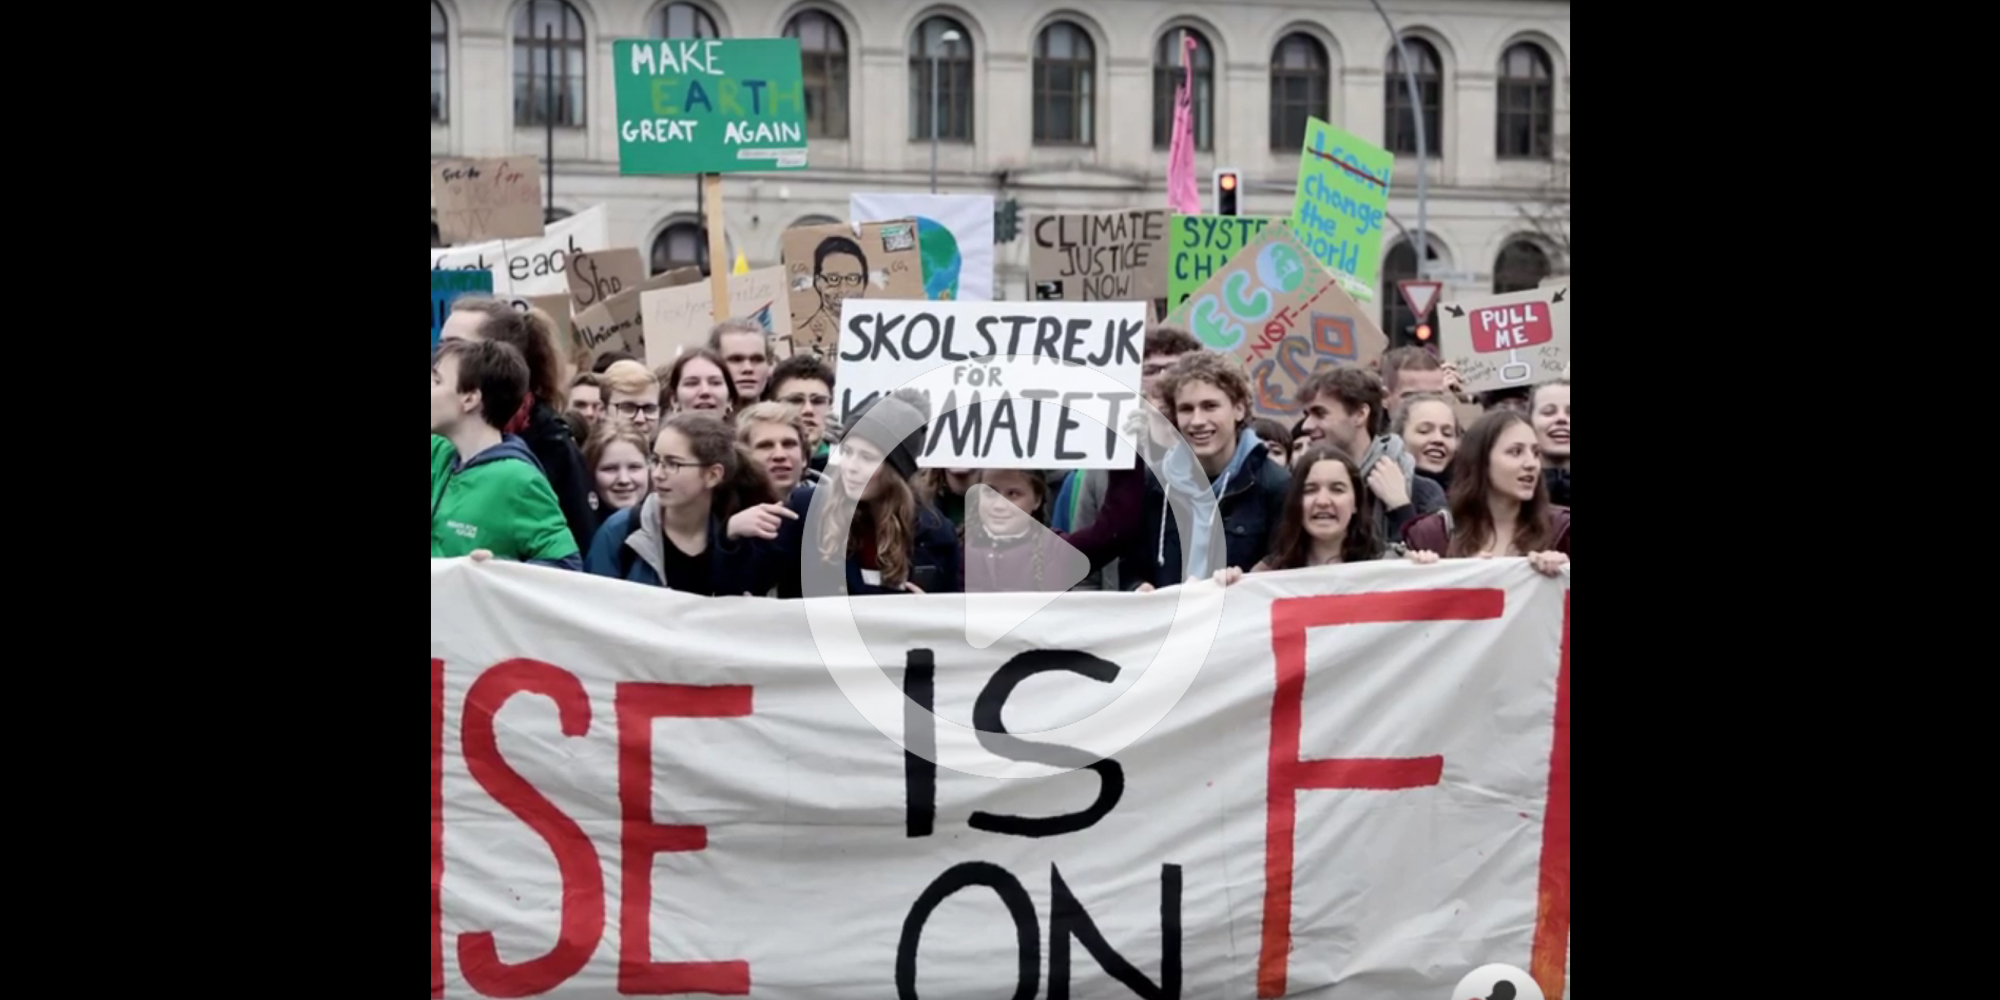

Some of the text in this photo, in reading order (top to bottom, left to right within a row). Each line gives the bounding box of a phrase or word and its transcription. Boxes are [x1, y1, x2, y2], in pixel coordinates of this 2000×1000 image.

[631, 41, 724, 75] MAKE
[651, 79, 800, 116] EARTH
[622, 119, 801, 144] GREAT AGAIN
[1301, 199, 1336, 237] the
[1304, 173, 1383, 235] change
[1034, 210, 1164, 248] CLIMATE
[1183, 216, 1287, 250] SYST
[1059, 242, 1152, 276] JUSTICE
[1082, 274, 1130, 301] NOW
[1190, 241, 1305, 352] ECO
[1250, 306, 1294, 359] NOT
[1480, 304, 1538, 331] PULL
[840, 312, 1144, 367] SKOLSTREJK
[1495, 325, 1528, 349] ME
[953, 364, 1003, 387] FÖR
[841, 387, 1137, 461] KMATET
[431, 657, 754, 999] SE
[904, 648, 1124, 838] IS
[896, 860, 1182, 1000] ON
